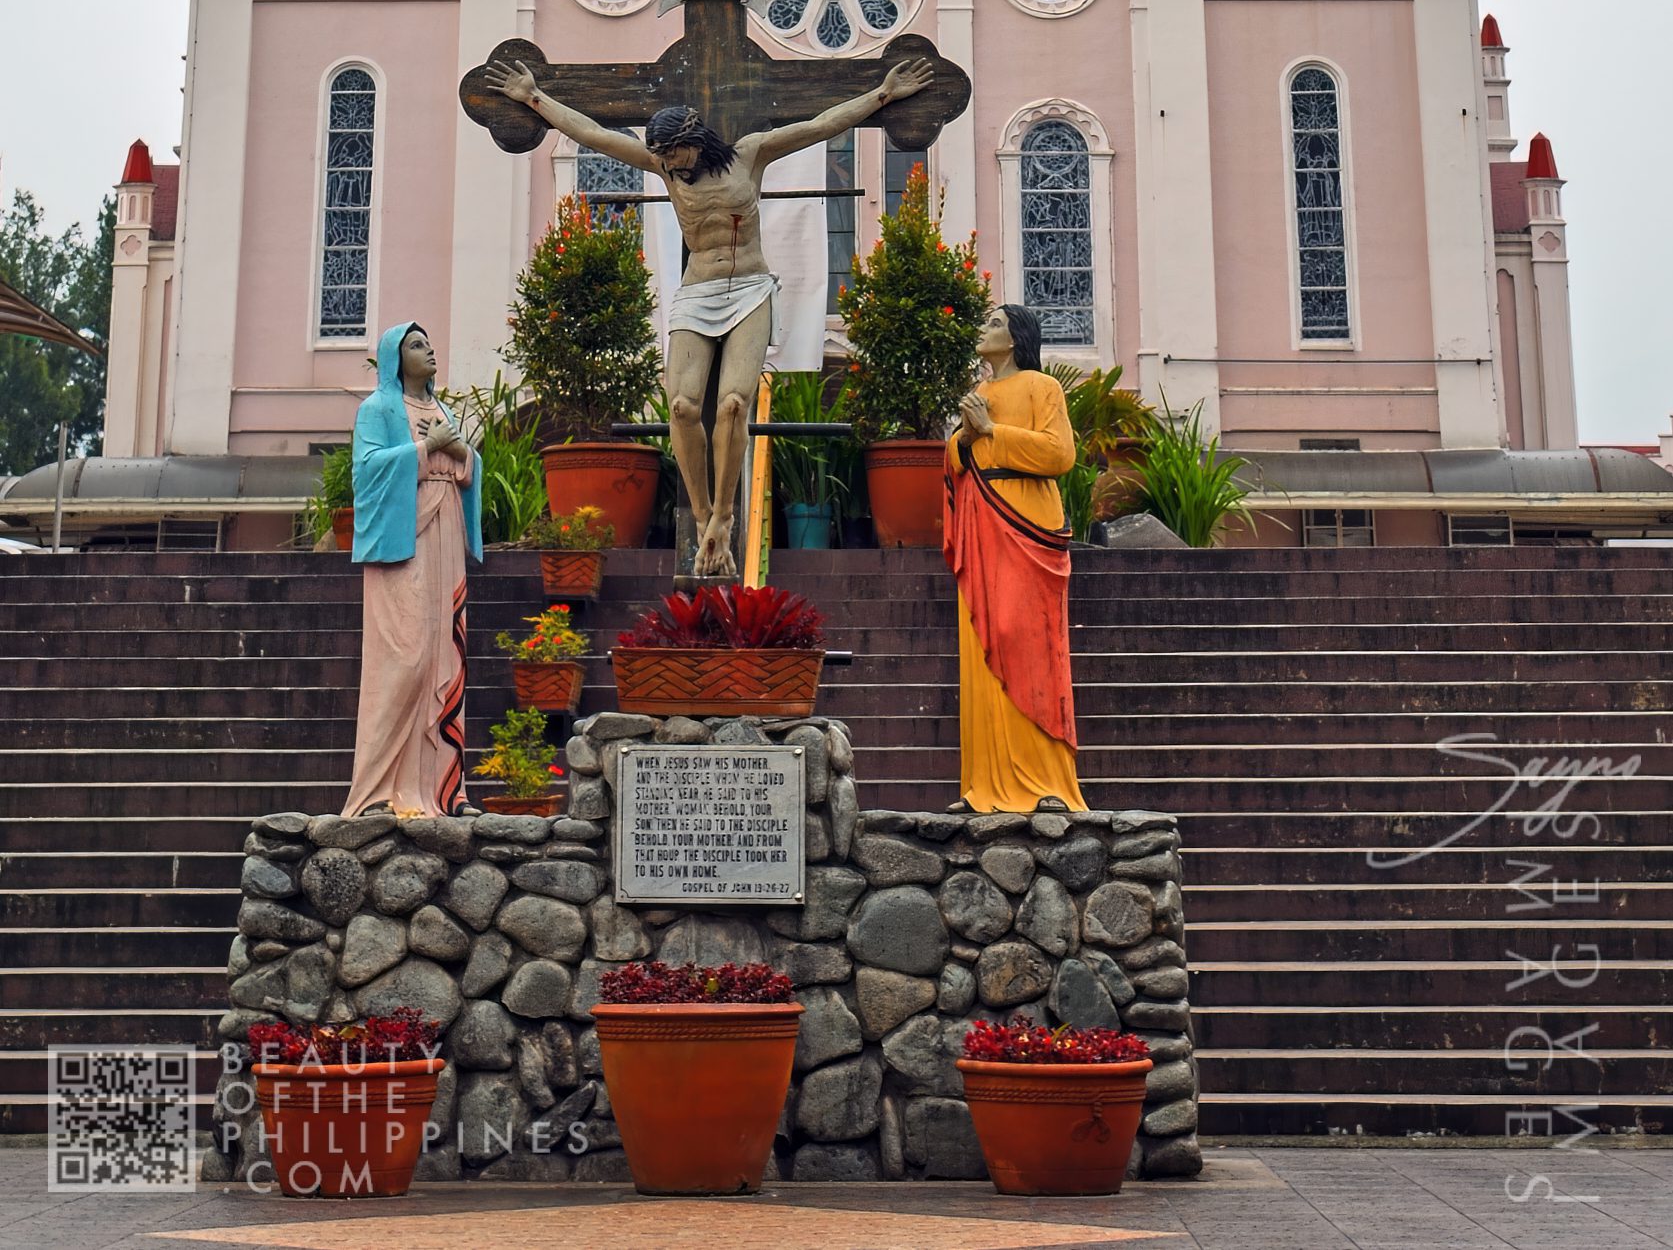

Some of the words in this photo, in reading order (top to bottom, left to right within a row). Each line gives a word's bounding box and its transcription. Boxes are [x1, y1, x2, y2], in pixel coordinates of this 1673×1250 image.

[636, 756, 660, 769] WHEN
[664, 757, 688, 769] JESUS
[693, 757, 711, 770] SAW
[716, 758, 728, 770] HIS
[636, 771, 651, 785] AND
[655, 772, 669, 785] THE
[674, 772, 710, 786] DISCIPLE
[744, 773, 755, 785] HE
[758, 773, 784, 786] LOVED
[635, 787, 674, 800] STANDING
[703, 788, 714, 801] HE
[717, 788, 736, 801] SAID
[740, 788, 751, 801] TO
[754, 788, 768, 801] HIS
[750, 803, 772, 817] YOUR
[680, 818, 690, 831] HE
[694, 818, 712, 832] SAID
[716, 819, 726, 832] TO
[729, 819, 744, 832] THE
[748, 819, 788, 832] DISCIPLE
[672, 834, 694, 847] YOUR
[738, 834, 754, 847] AND
[757, 834, 782, 847] FROM
[635, 849, 654, 862] THAT
[684, 849, 699, 862] THE
[703, 849, 742, 863] DISCIPLE
[745, 850, 768, 863] TOOK
[770, 851, 787, 863] HER
[635, 865, 646, 878] TO
[649, 865, 664, 878] HIS
[668, 865, 689, 878] OWN
[682, 882, 714, 893] GOSPEL
[717, 882, 728, 893] OF
[731, 882, 752, 893] JOHN
